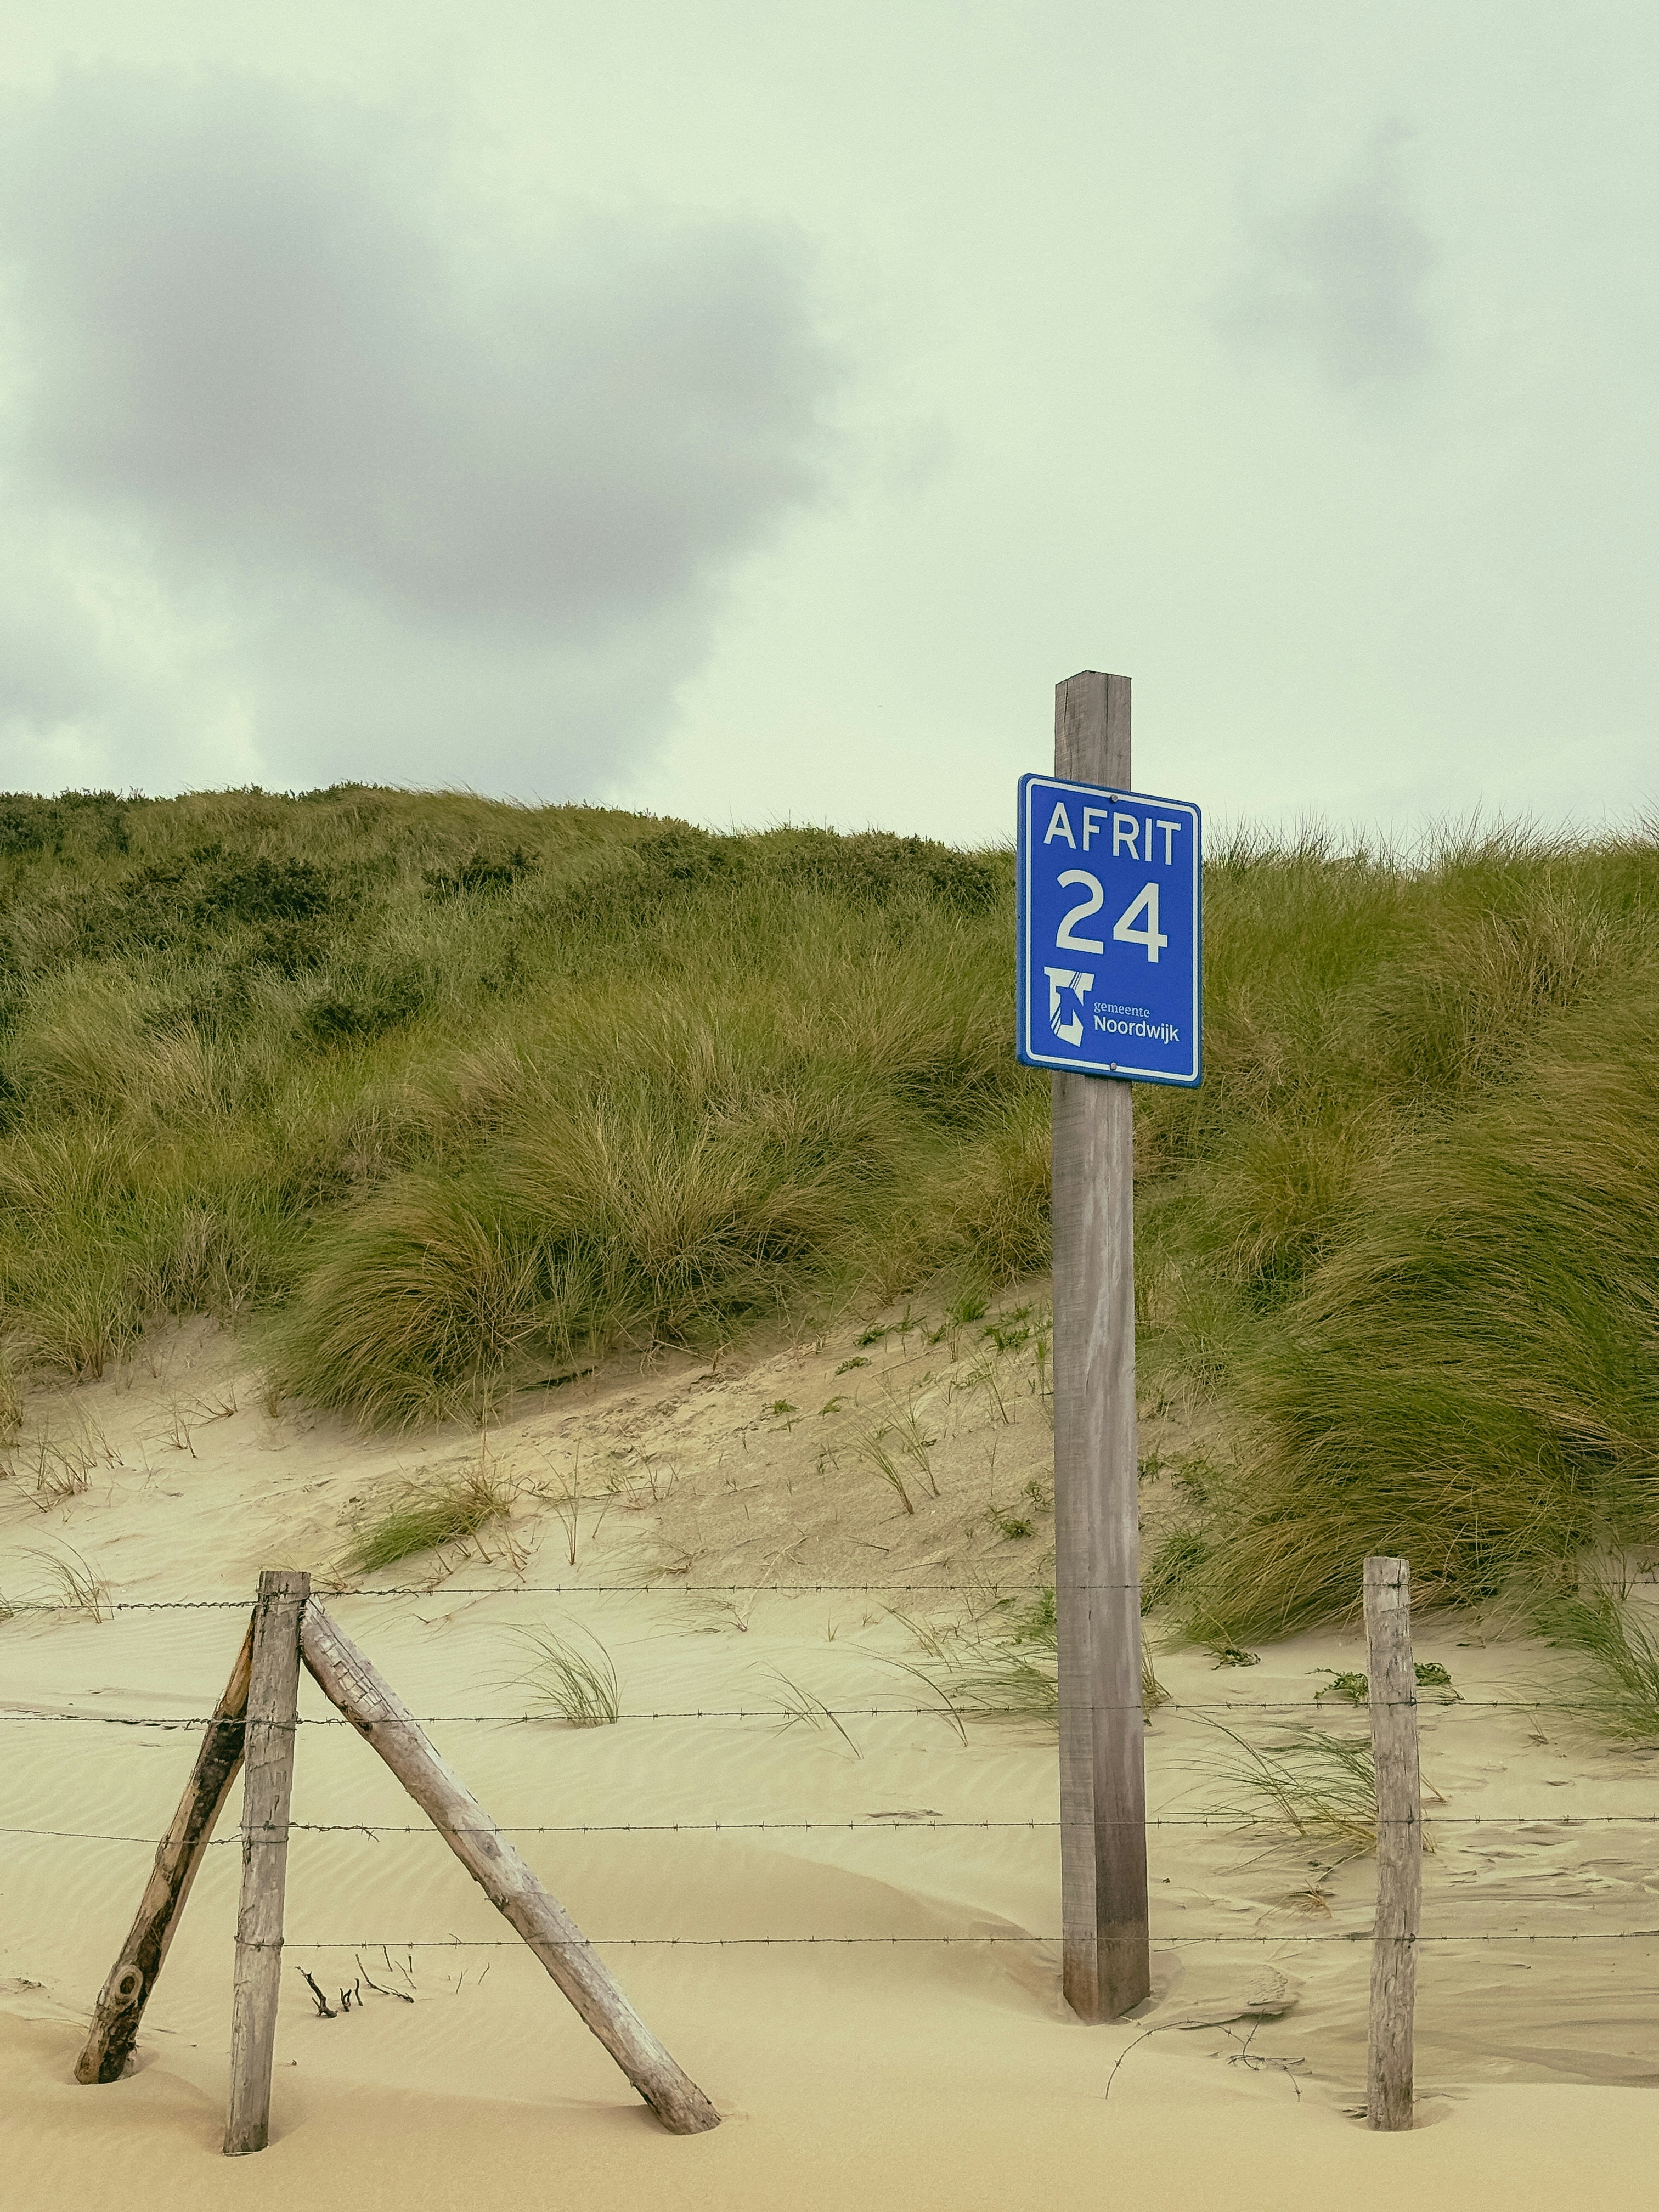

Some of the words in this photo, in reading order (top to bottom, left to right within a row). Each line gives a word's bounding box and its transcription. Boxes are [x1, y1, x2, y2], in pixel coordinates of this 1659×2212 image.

[1043, 802, 1181, 866] AFRIT
[1056, 869, 1168, 963] 24
[1093, 1002, 1150, 1018] gemeente
[1093, 1015, 1180, 1045] Noordwijk
